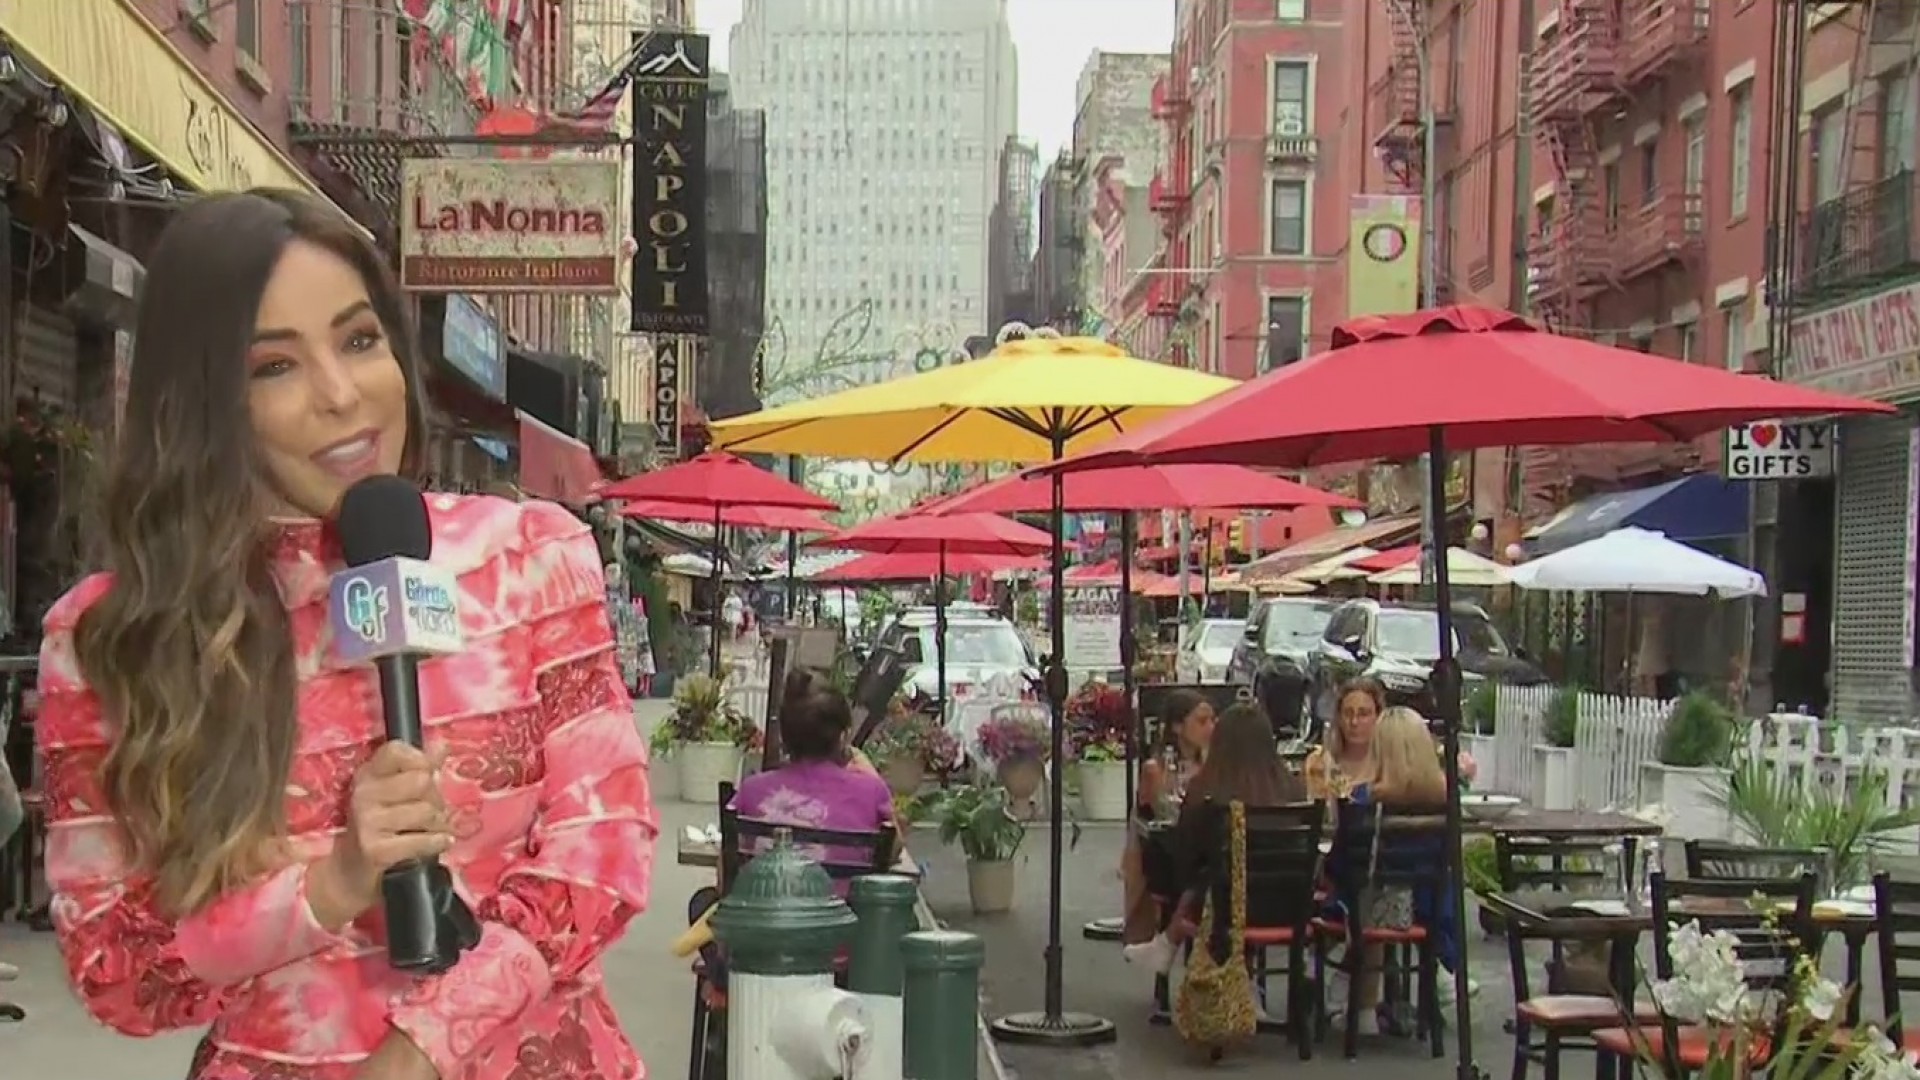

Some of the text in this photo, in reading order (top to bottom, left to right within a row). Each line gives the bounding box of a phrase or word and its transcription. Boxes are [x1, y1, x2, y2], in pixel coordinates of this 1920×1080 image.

[416, 197, 604, 235] La Nonna
[648, 104, 690, 307] NAPOLI
[418, 262, 600, 280] Ristorante Italiano
[1733, 455, 1812, 476] GIFTS
[1062, 588, 1121, 602] ZAGAT
